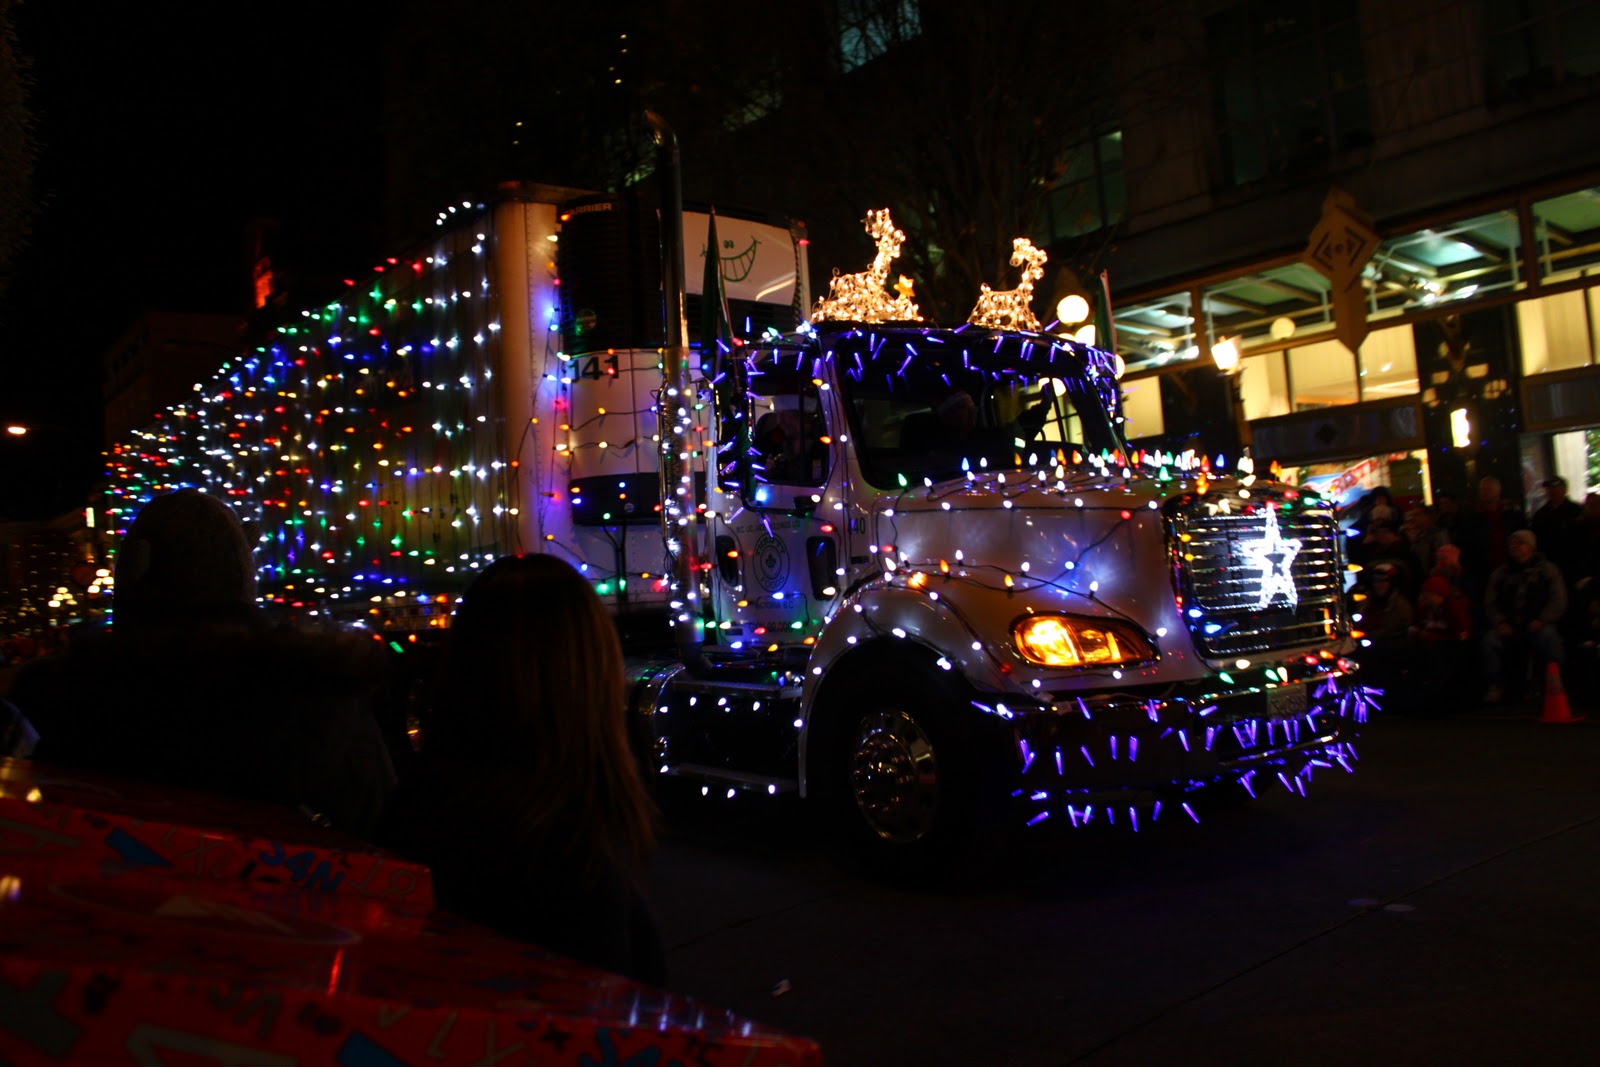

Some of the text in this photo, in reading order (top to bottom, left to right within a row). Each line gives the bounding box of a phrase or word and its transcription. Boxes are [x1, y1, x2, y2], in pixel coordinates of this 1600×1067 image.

[562, 202, 612, 215] ARRIER
[568, 355, 619, 382] 141
[760, 574, 786, 590] FOODS
